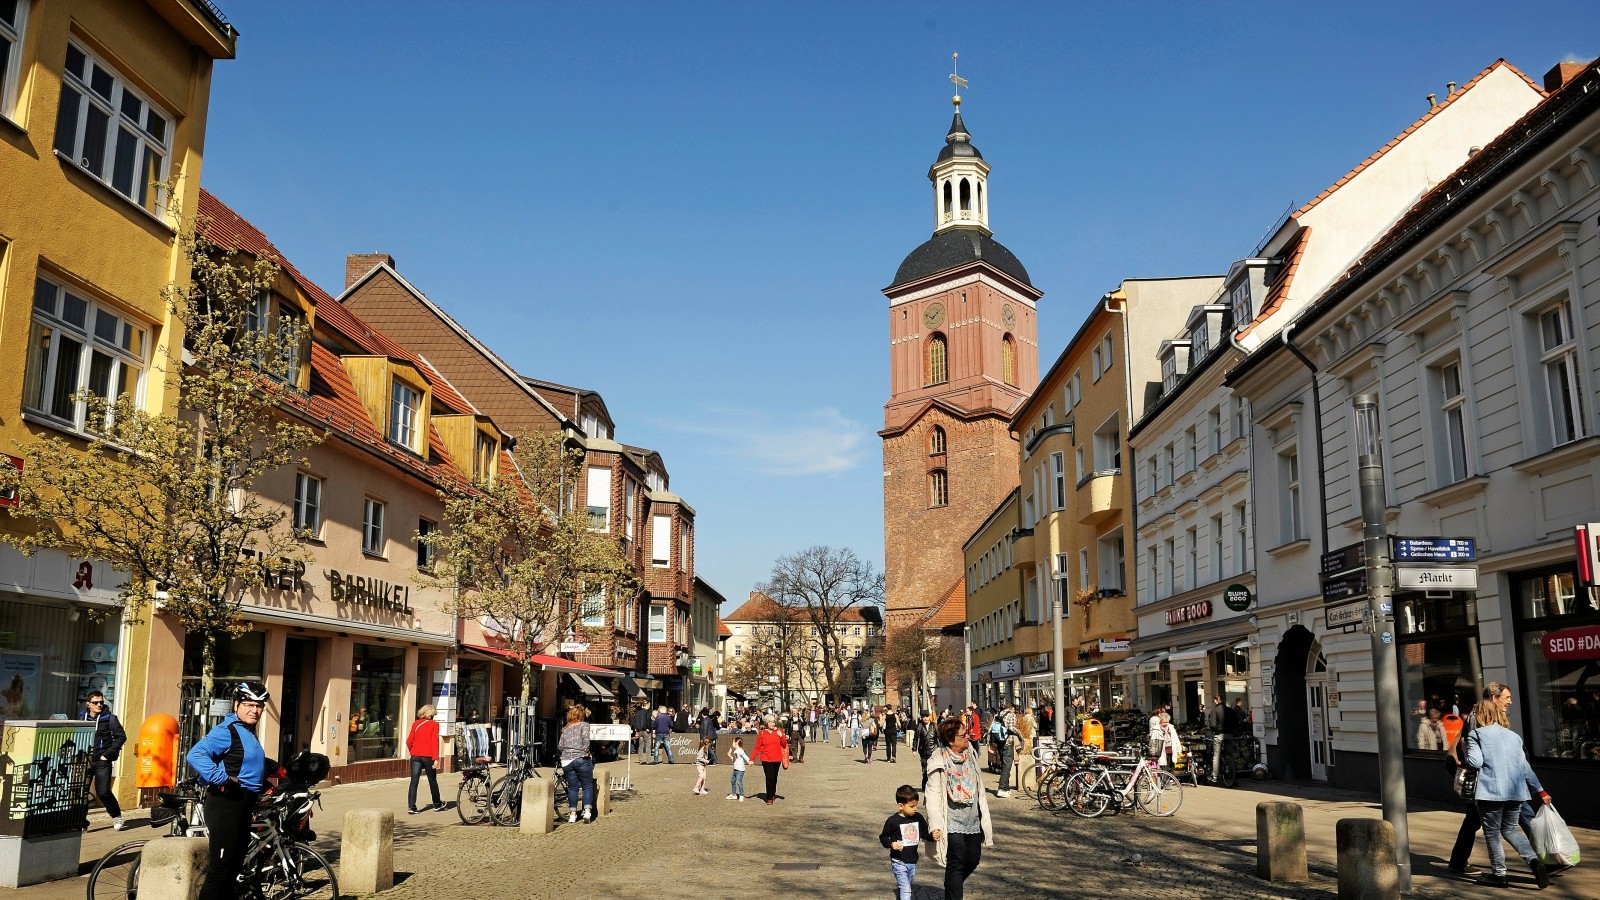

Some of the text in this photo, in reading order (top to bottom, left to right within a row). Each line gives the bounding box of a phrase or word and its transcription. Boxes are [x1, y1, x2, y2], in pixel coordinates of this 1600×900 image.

[1419, 572, 1452, 584] Markt
[330, 568, 413, 616] BARNIKEL
[1549, 638, 1575, 653] SEID
